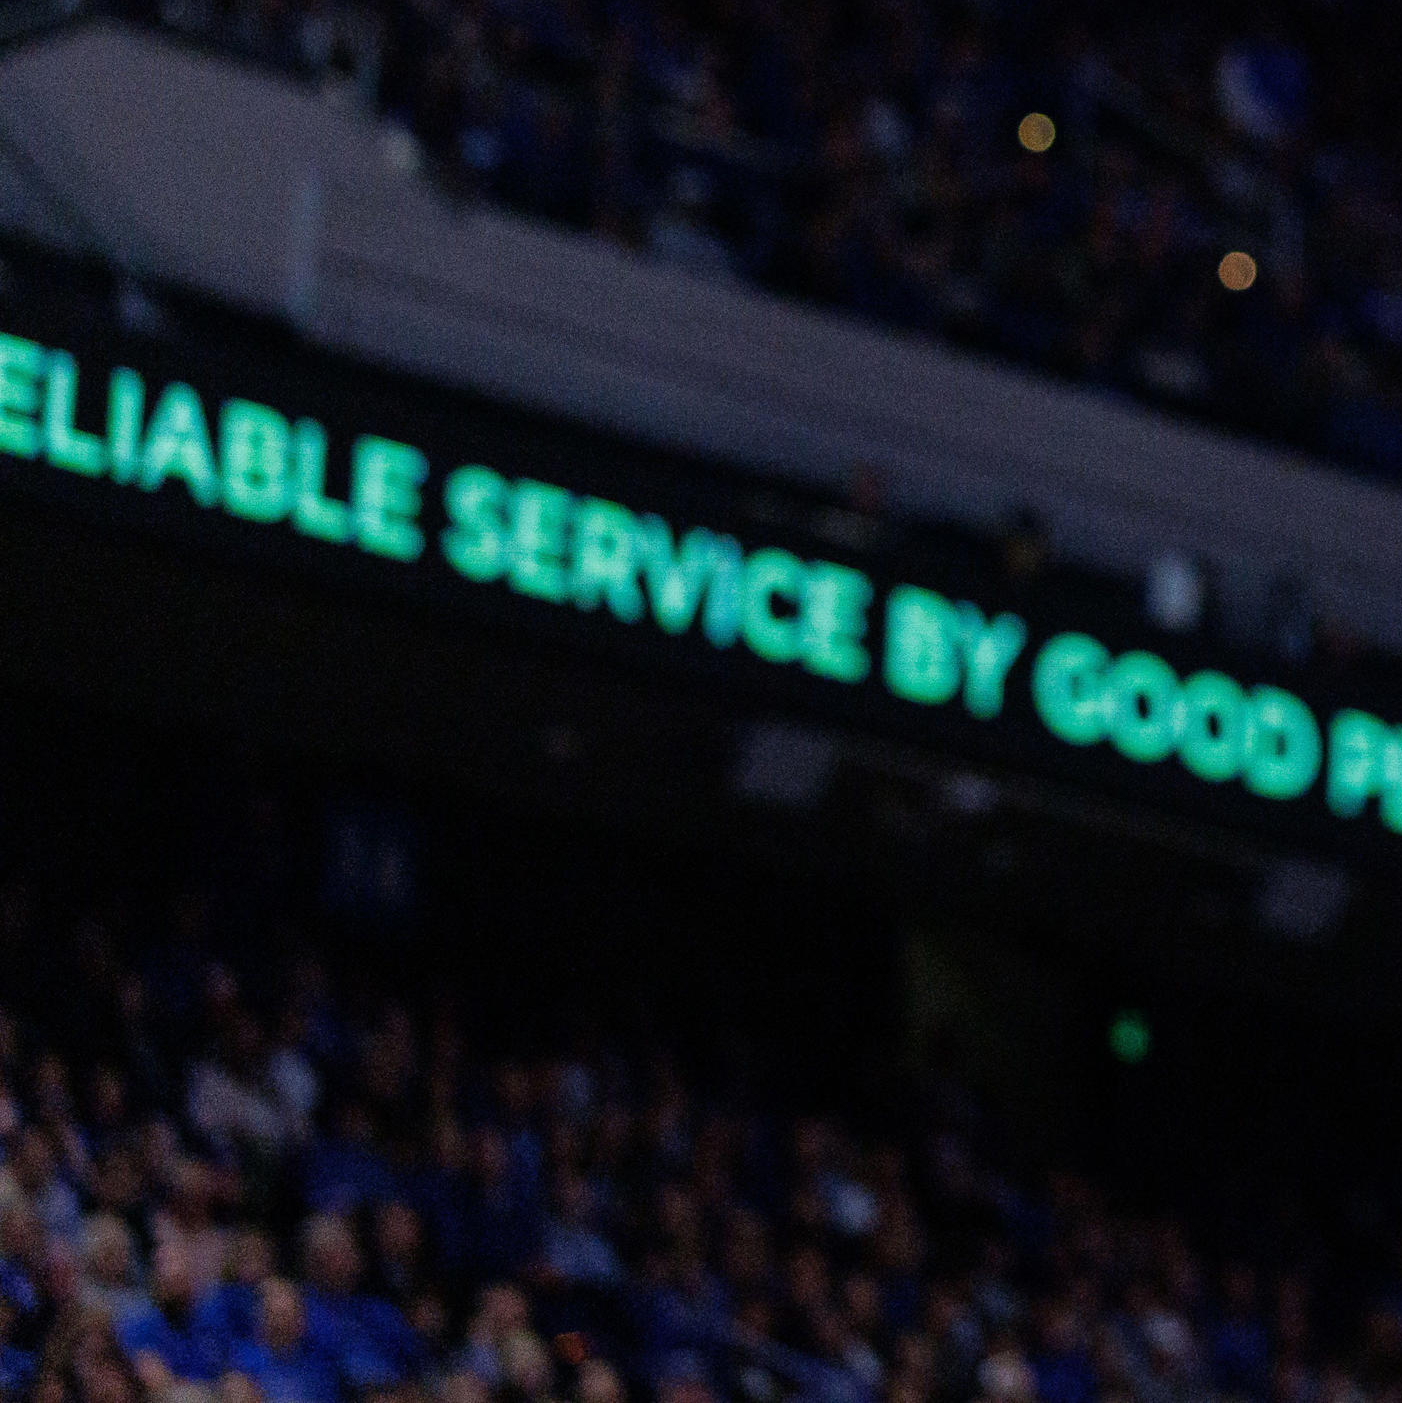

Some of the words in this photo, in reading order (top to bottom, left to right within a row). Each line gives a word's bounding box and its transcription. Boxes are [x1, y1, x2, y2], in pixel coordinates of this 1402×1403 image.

[442, 464, 872, 684] SERVICE
[883, 582, 1027, 719] BY
[1031, 631, 1321, 800] GOOD
